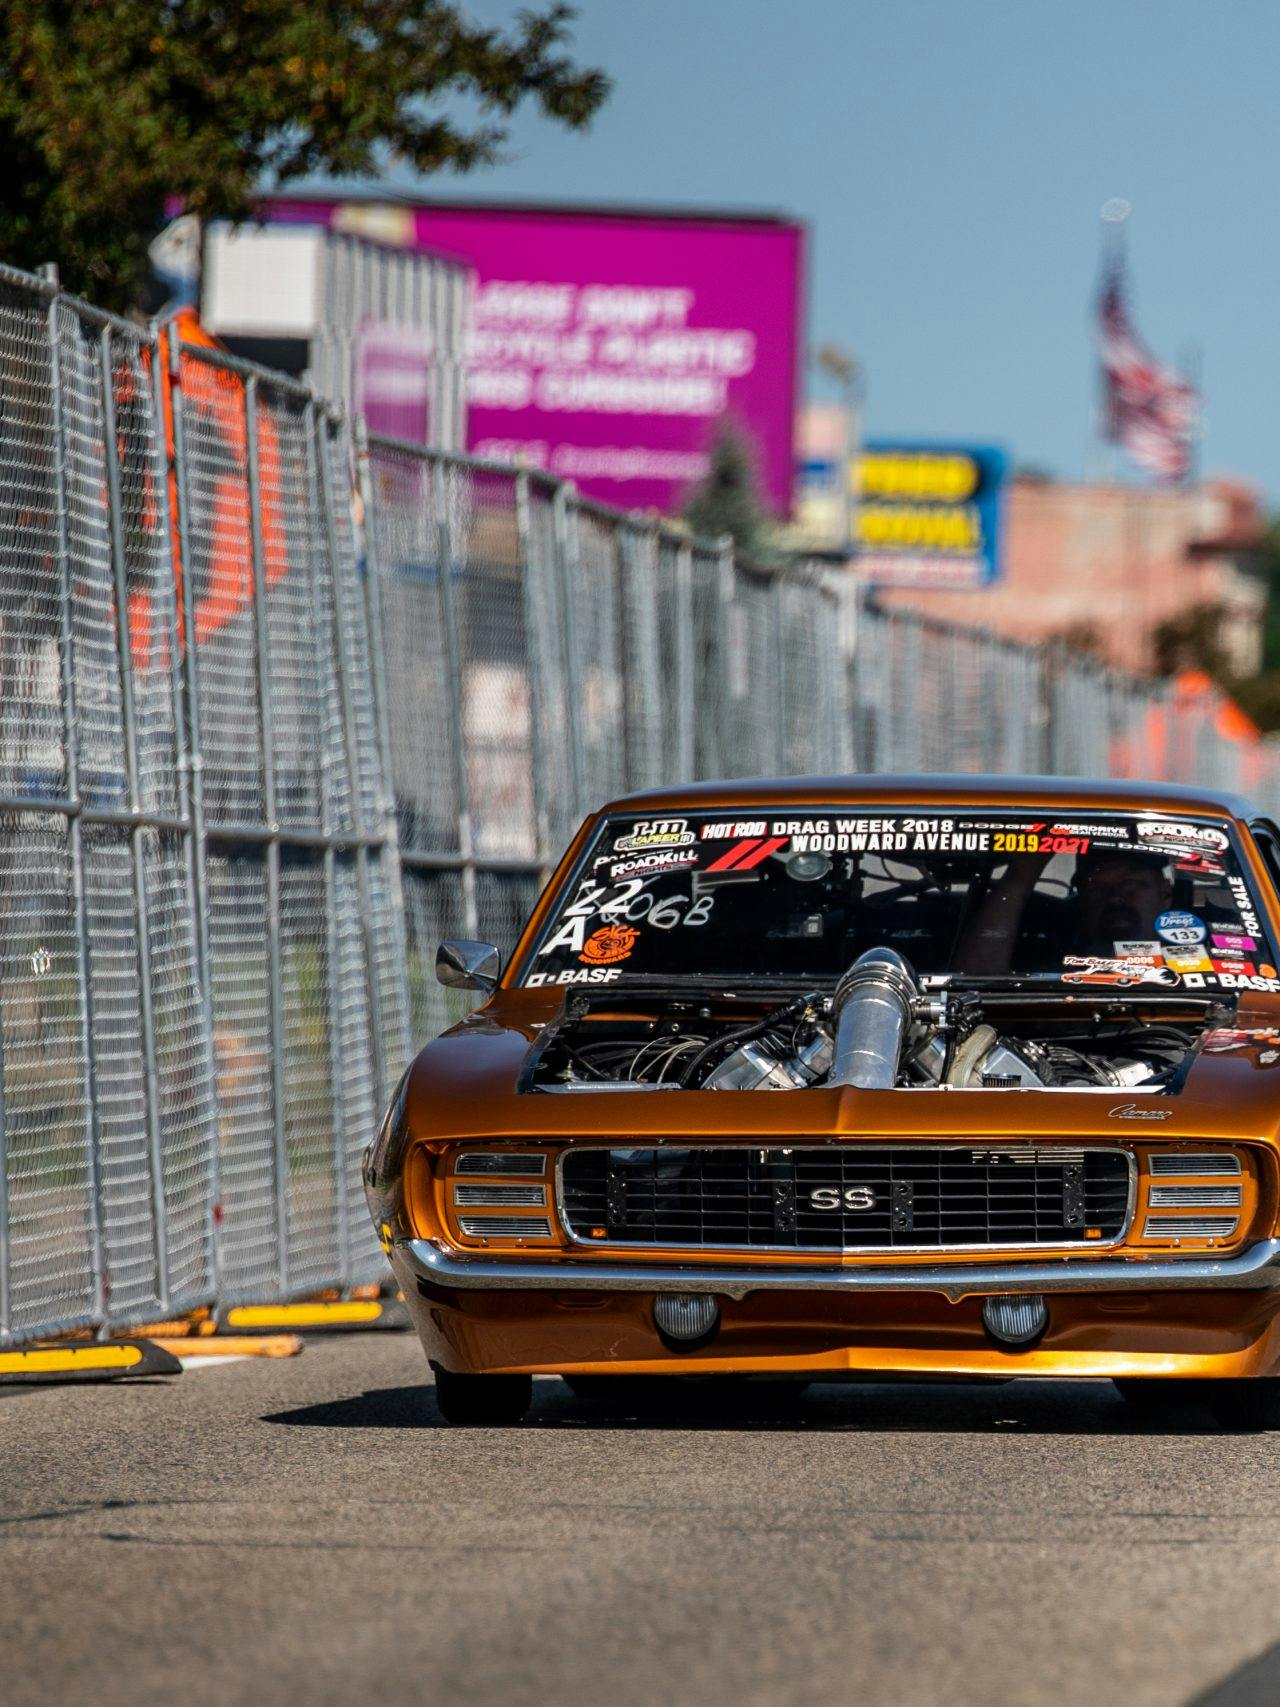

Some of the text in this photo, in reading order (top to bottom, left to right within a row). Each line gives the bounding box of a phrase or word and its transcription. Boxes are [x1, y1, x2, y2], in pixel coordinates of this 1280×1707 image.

[702, 823, 734, 839] HOT
[734, 822, 766, 837] ROD
[772, 820, 829, 835] DRAG
[836, 820, 896, 833] WEEK
[902, 819, 954, 833] 2018
[792, 833, 1090, 854] WOODWARD AVENUE 2019 2021
[610, 849, 699, 877] ROADKILL
[1227, 876, 1252, 910] SALE
[538, 916, 586, 955] A
[1170, 931, 1200, 940] 133
[1240, 911, 1263, 938] FOR
[556, 968, 622, 985] BASF
[809, 1187, 876, 1211] SS
